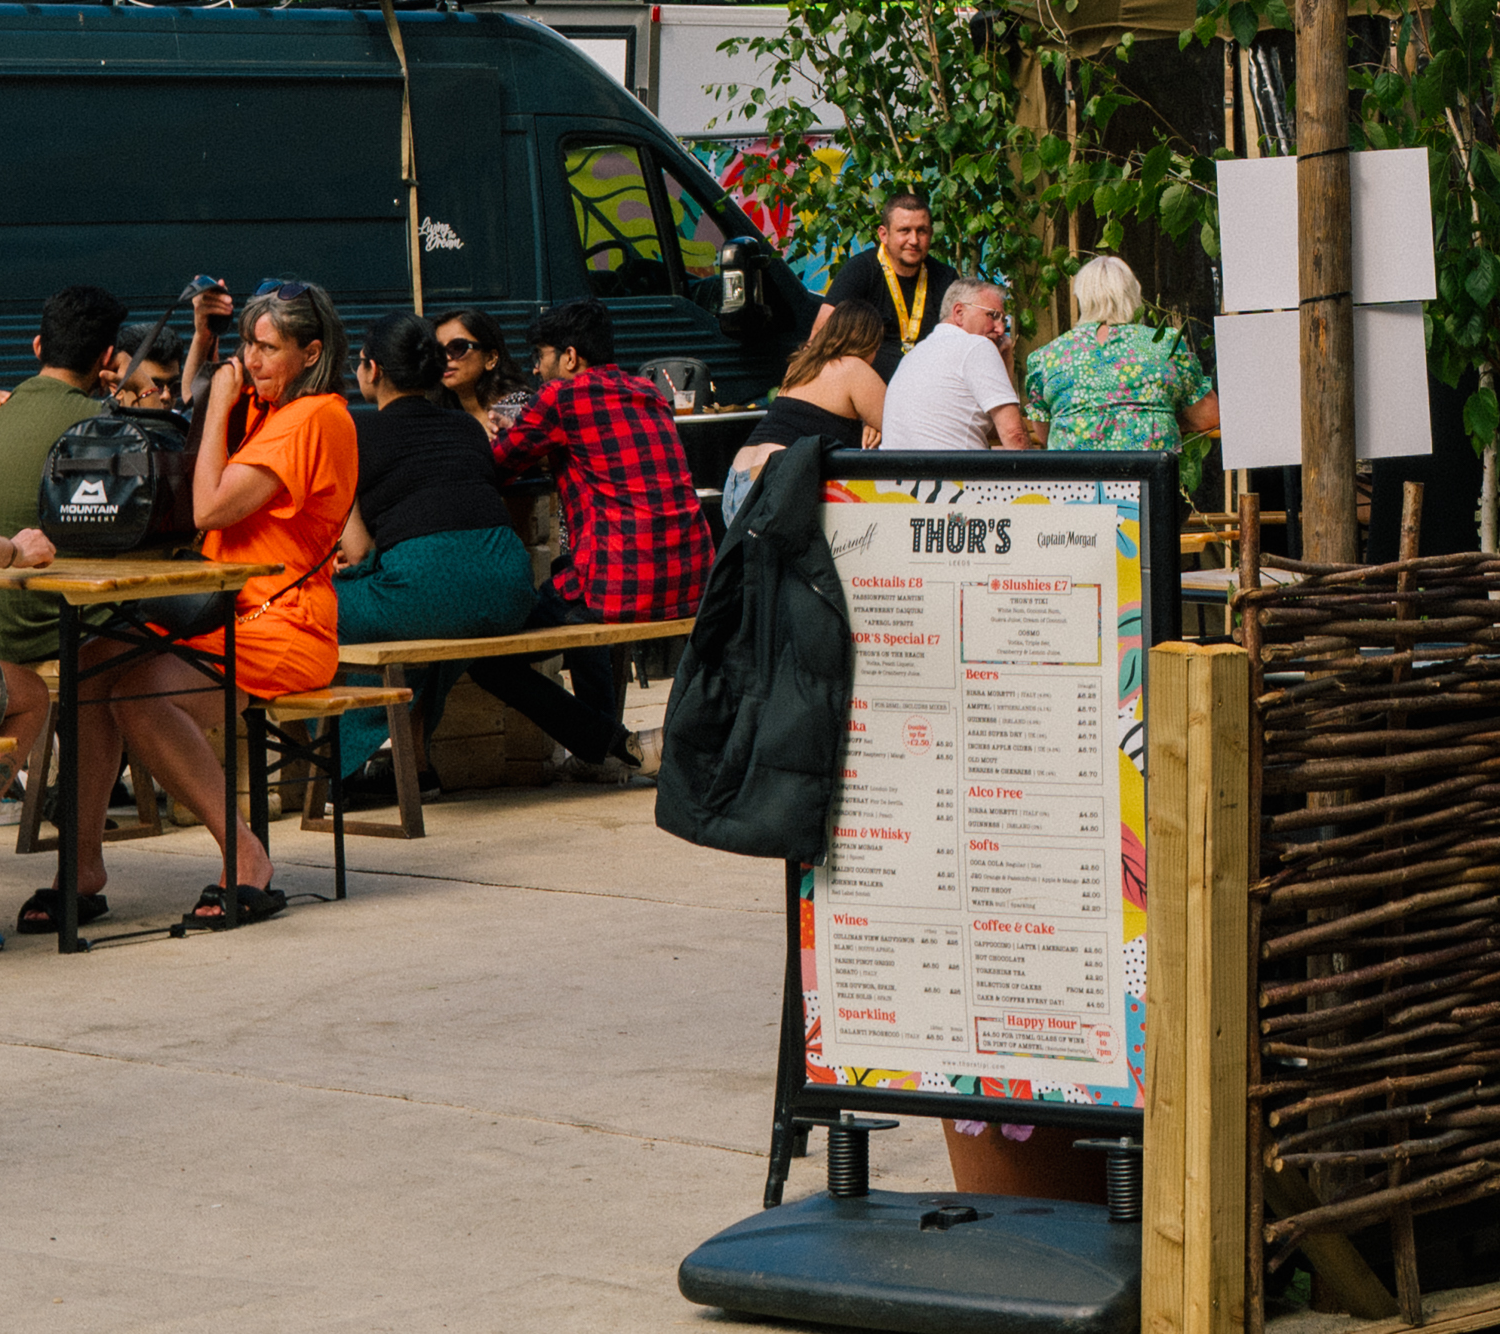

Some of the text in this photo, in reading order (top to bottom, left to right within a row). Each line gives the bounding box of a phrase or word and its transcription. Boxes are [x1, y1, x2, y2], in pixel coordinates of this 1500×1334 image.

[60, 504, 119, 514] MOUNTAIN
[910, 513, 1011, 554] THOR'S
[1037, 531, 1066, 548] Captain
[1066, 531, 1097, 548] Morgan
[852, 576, 923, 588] Cocktails £8
[1002, 579, 1068, 591] Slushies £7
[883, 633, 924, 646] Special
[927, 634, 940, 645] £7
[966, 669, 999, 680] Beers
[968, 786, 1023, 799] Alco Free
[832, 826, 911, 843] Rum & Whisky
[969, 839, 999, 851] Softs
[833, 913, 868, 926] Wines
[973, 920, 1055, 934] Coffee & Cake
[838, 1008, 896, 1024] Sparkling
[1007, 1015, 1077, 1030] Happy Hour
